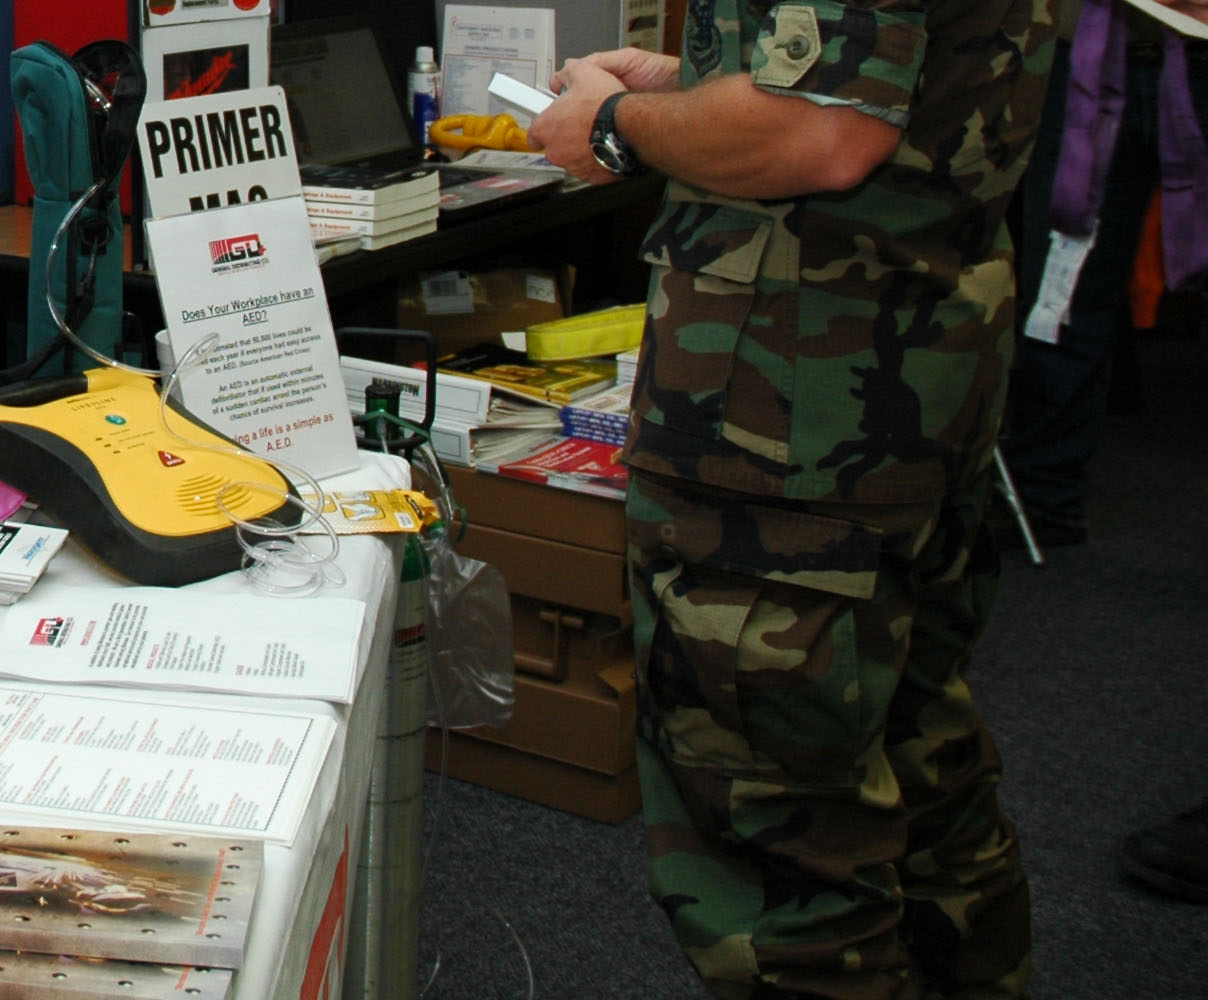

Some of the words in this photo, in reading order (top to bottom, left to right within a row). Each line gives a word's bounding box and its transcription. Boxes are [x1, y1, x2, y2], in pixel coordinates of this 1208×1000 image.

[145, 104, 288, 178] PRIMER
[181, 309, 206, 322] Does
[207, 303, 230, 316] Your
[231, 294, 279, 309] Workplace
[280, 290, 301, 301] have
[303, 287, 314, 297] an
[242, 309, 268, 324] AED?
[252, 431, 258, 441] a
[258, 426, 273, 439] life
[275, 423, 284, 435] is
[285, 423, 291, 432] a
[292, 415, 322, 430] simple
[323, 412, 334, 423] as
